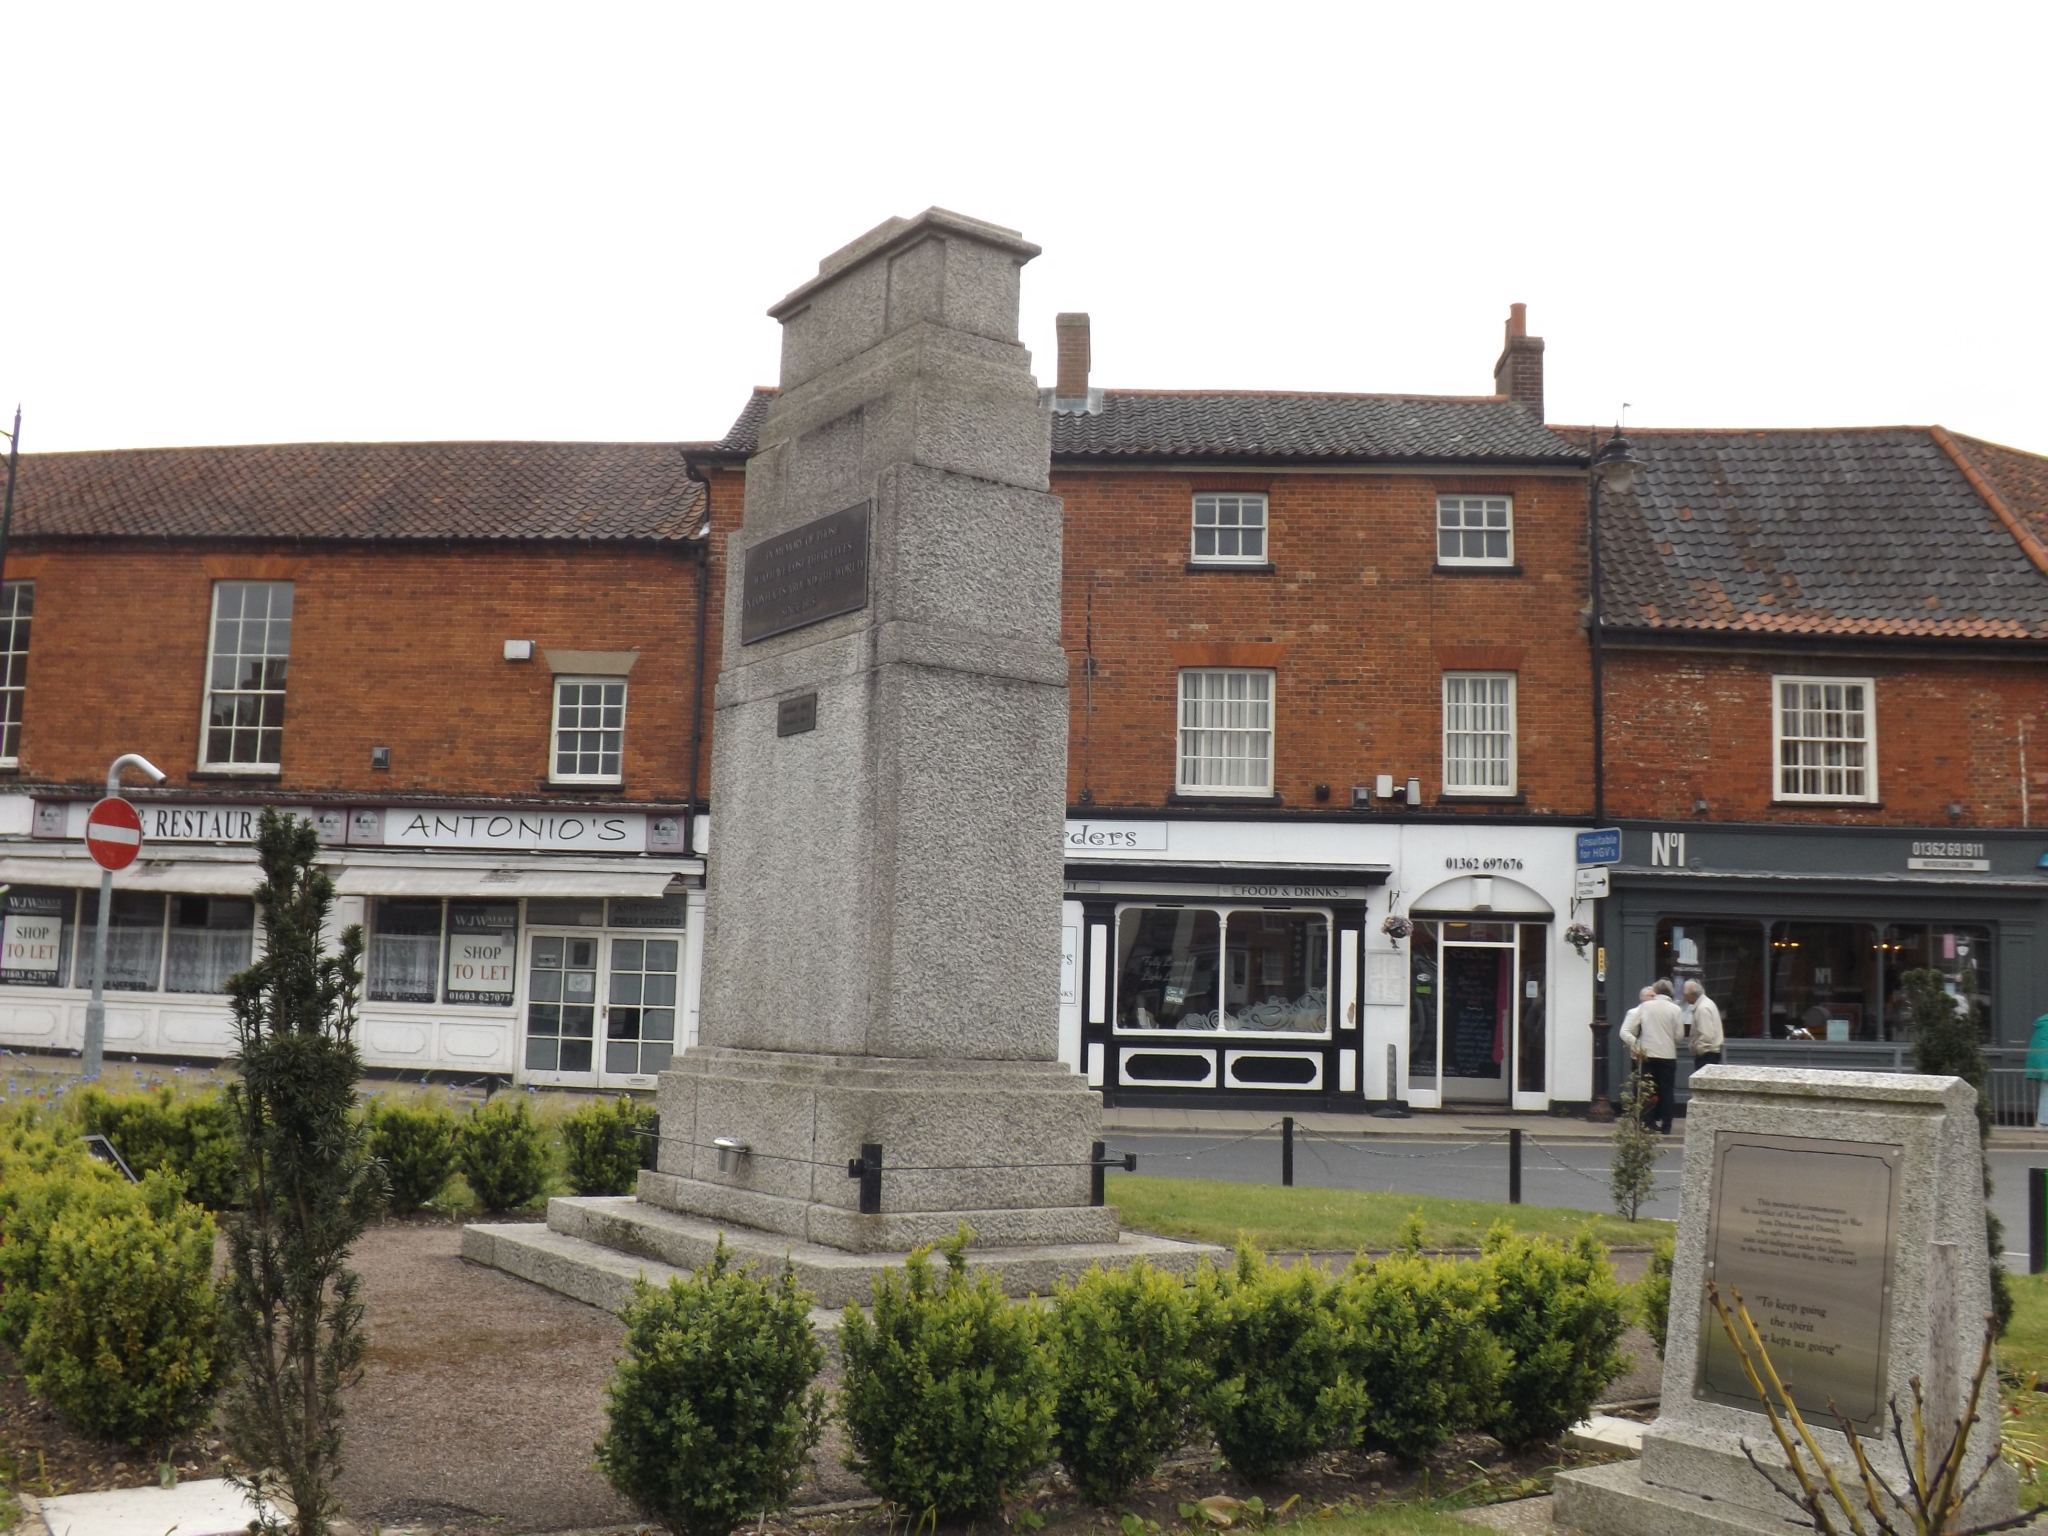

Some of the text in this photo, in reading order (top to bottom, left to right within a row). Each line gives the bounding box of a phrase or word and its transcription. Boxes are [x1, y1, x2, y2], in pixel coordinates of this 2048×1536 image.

[775, 538, 803, 557] MEMORY
[805, 534, 814, 546] OF
[816, 526, 839, 542] THOSE
[788, 557, 805, 573] LOST
[807, 549, 828, 567] THEIR
[830, 541, 852, 559] LIVES
[789, 575, 818, 594] AROUND
[835, 559, 864, 577] WORLD
[156, 809, 297, 840] RESTAUR
[401, 814, 626, 841] ANTONIO'S
[1578, 836, 1617, 847] Unsuitable
[1580, 850, 1591, 858] for
[1446, 857, 1523, 870] 01362 697676
[1241, 886, 1339, 897] FOOD & DRINKS
[16, 926, 49, 939] SHOP
[6, 944, 56, 959] TO LET
[464, 946, 501, 959] SHOP
[2, 970, 56, 980] 01603 627077
[453, 964, 509, 980] TO LET
[449, 992, 511, 1001] 01603 627077
[1758, 1198, 1771, 1206] This
[1772, 1201, 1800, 1210] memorial
[1758, 1218, 1772, 1226] from
[1785, 1211, 1794, 1219] Far
[1811, 1214, 1840, 1224] Prisoners
[1850, 1218, 1863, 1226] War
[1776, 1299, 1797, 1314] keep
[1800, 1305, 1827, 1318] going
[1770, 1315, 1814, 1332] the spirit
[1748, 1333, 1768, 1342] tat
[1770, 1333, 1791, 1348] kept
[1794, 1340, 1805, 1349] us
